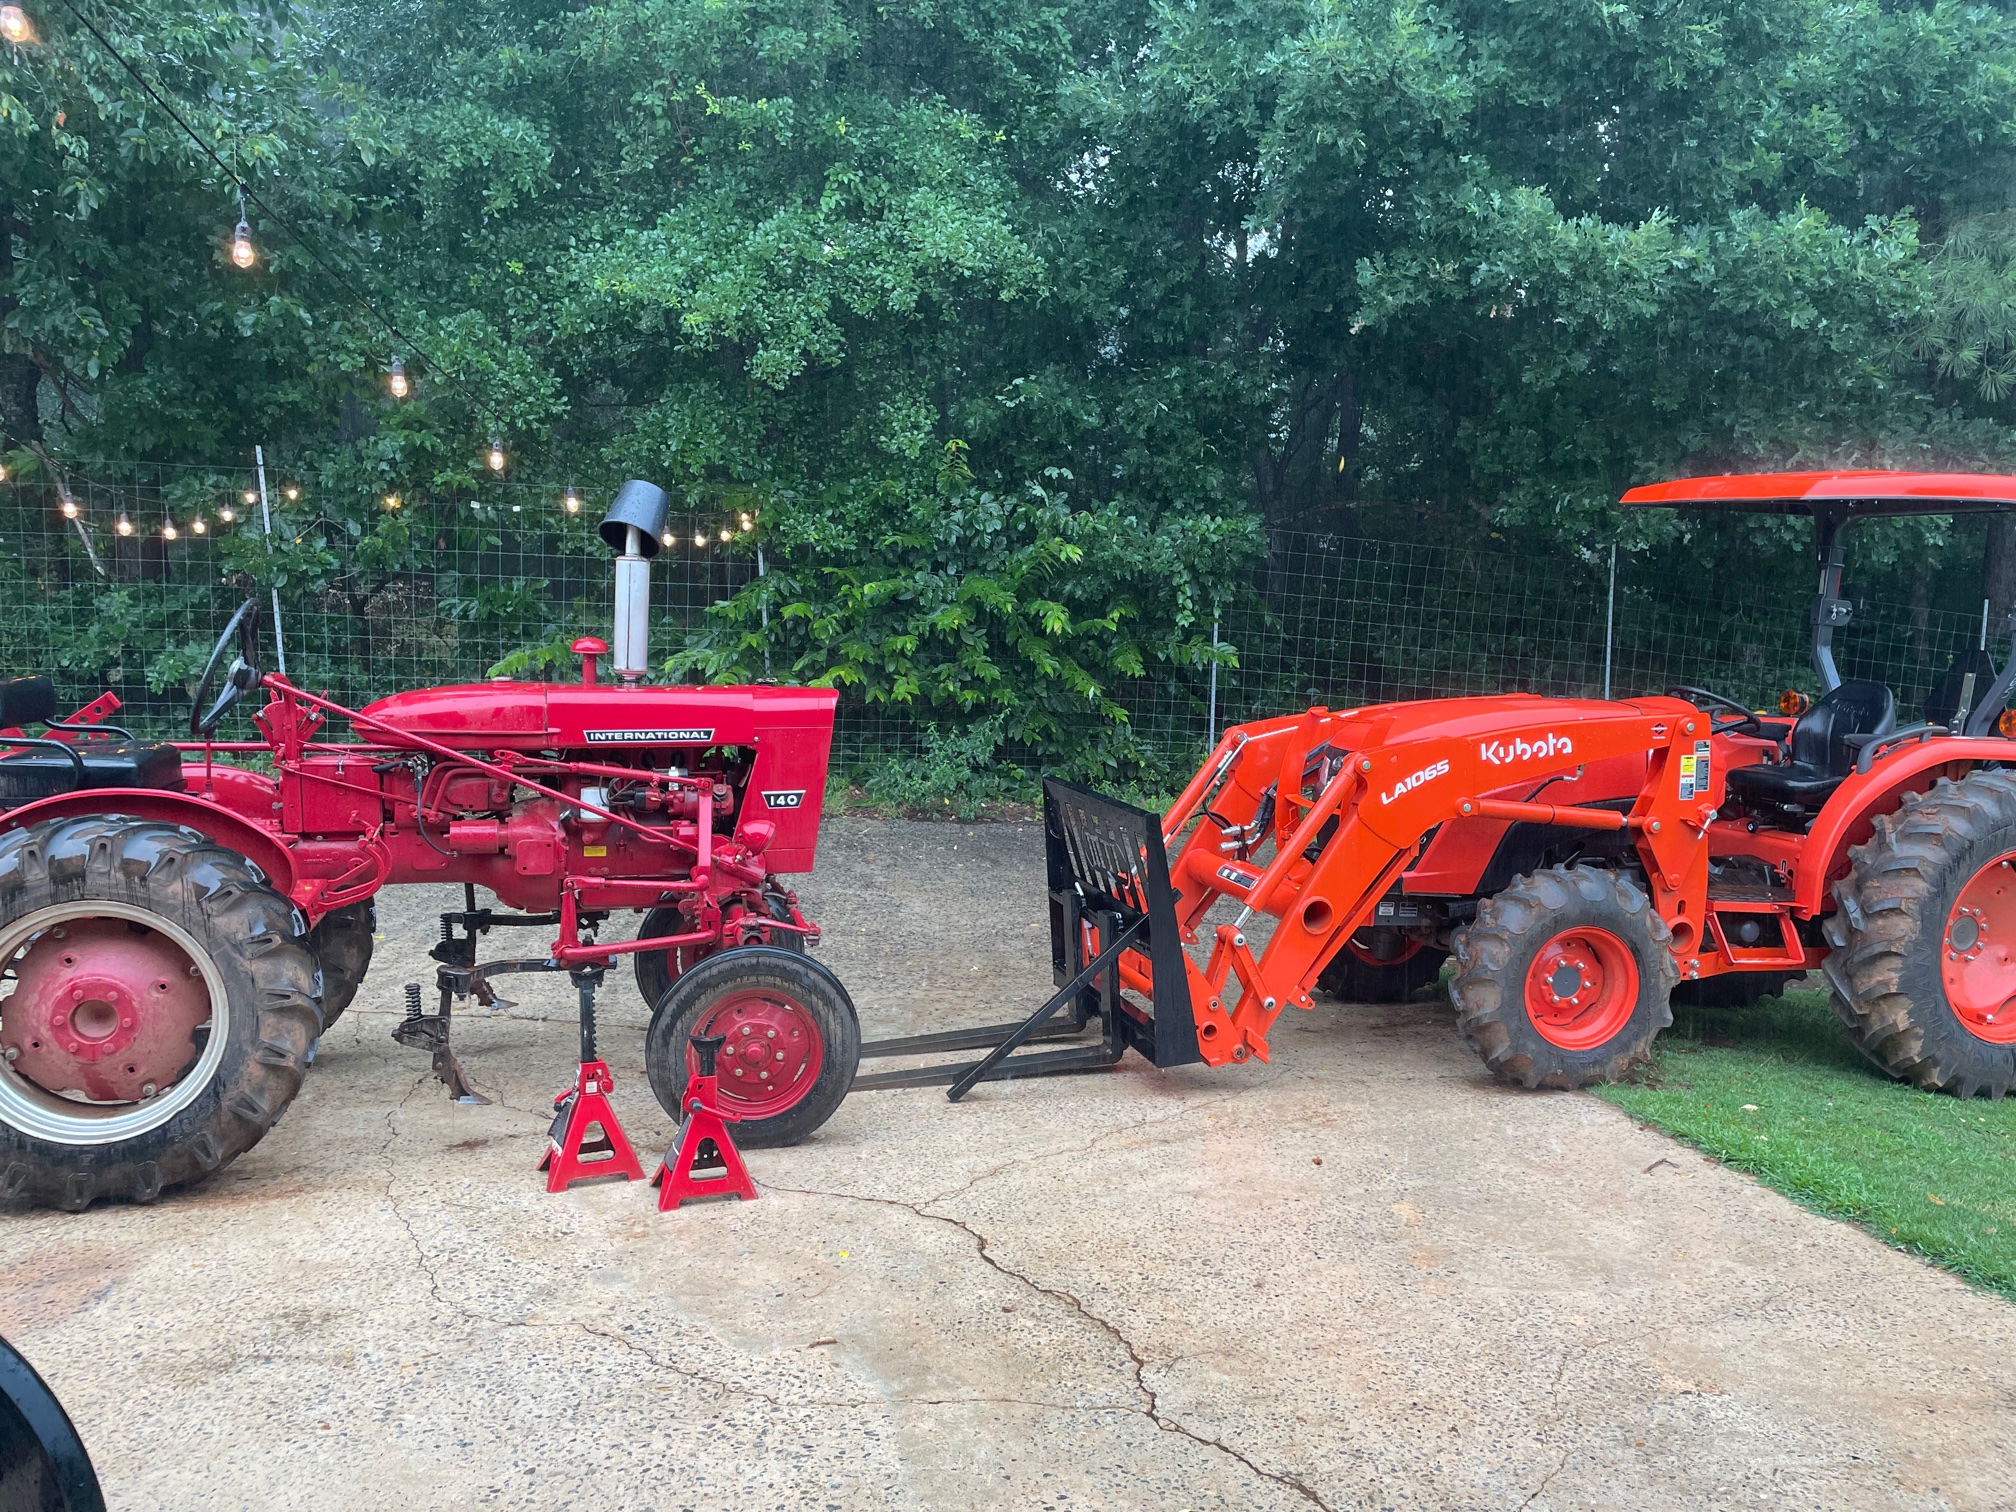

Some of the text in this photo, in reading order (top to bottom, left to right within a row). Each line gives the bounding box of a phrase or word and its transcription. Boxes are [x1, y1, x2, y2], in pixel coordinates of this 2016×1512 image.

[590, 731, 708, 740] INTERNATIONAL
[1480, 732, 1573, 765] Kubota
[1380, 759, 1450, 805] LA1065
[770, 795, 798, 806] 140
